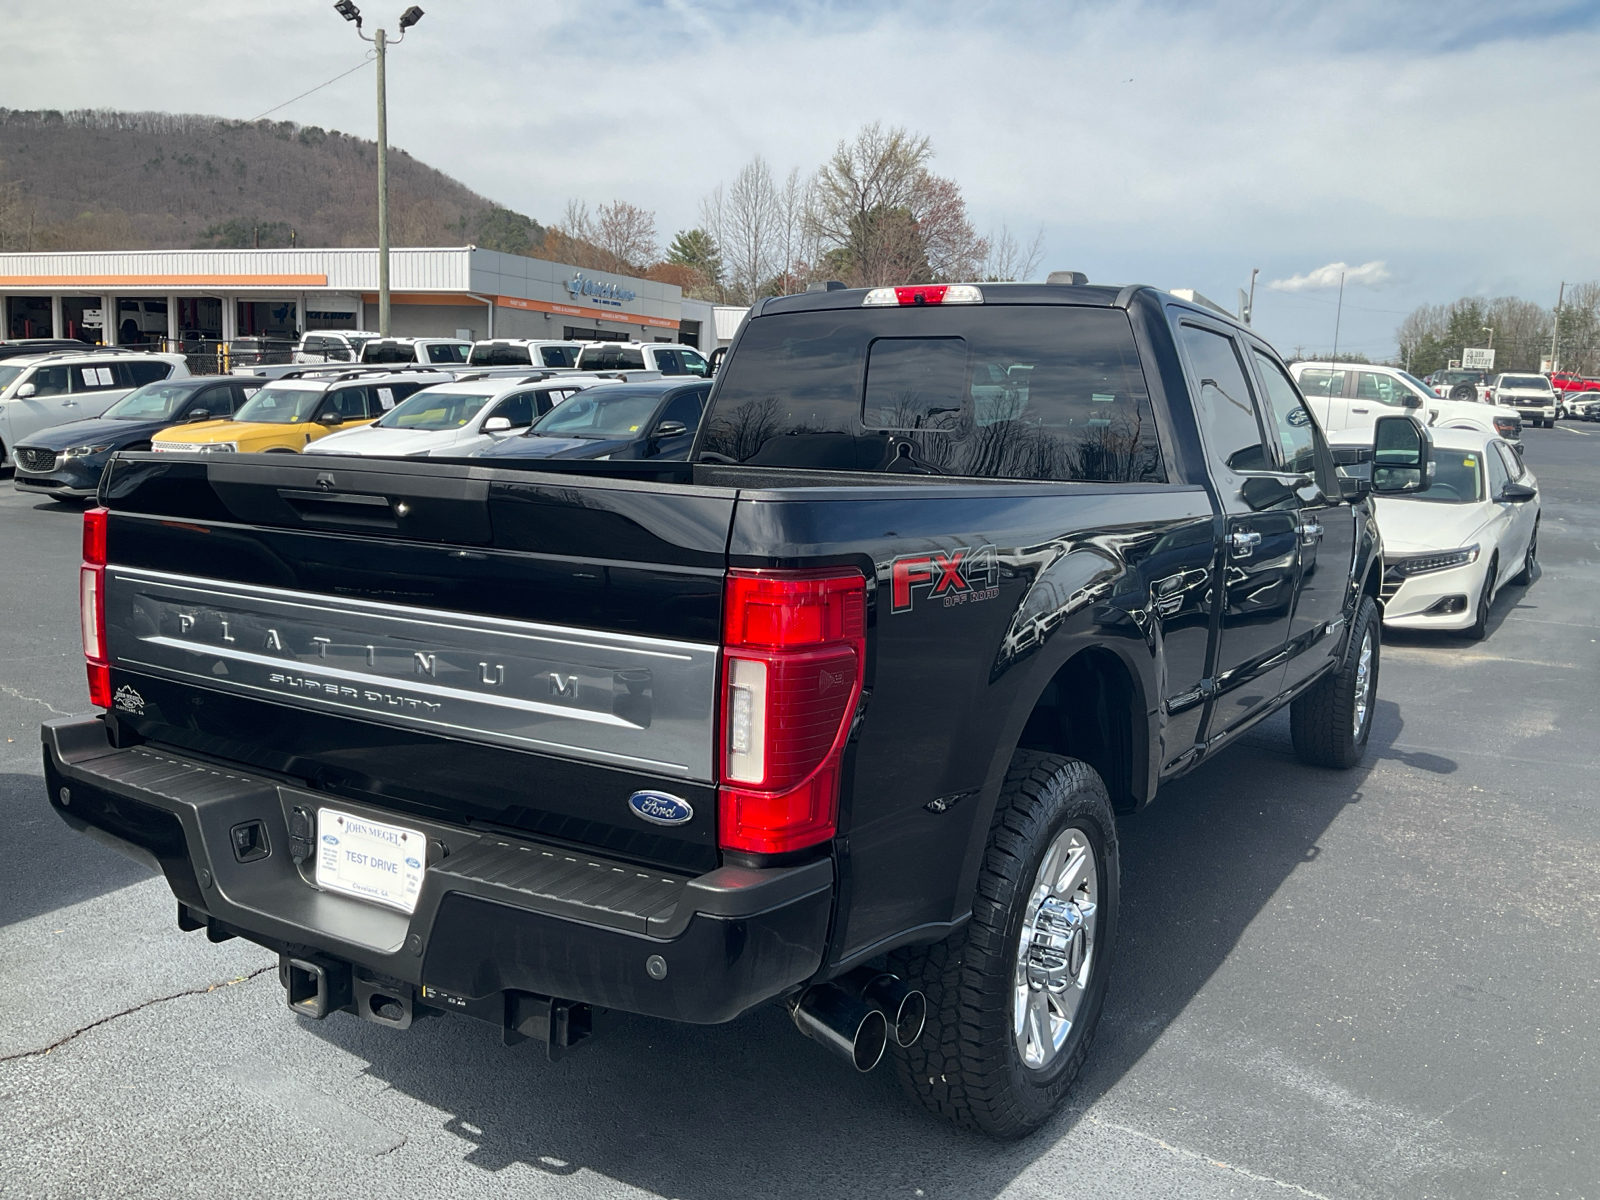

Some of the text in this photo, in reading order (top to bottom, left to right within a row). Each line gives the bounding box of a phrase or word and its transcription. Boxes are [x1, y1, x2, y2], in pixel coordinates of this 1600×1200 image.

[584, 279, 636, 301] Quick Lane
[890, 544, 999, 615] FX4
[944, 588, 1000, 608] OFF ROAD
[178, 614, 579, 699] PLATINUM
[269, 673, 441, 712] SUPER DUTY
[641, 796, 677, 818] Ford
[345, 821, 401, 847] JOHN MEGEL
[345, 850, 369, 866] TEST
[370, 857, 398, 874] DRIVE
[352, 882, 389, 898] Cleveland, GA
